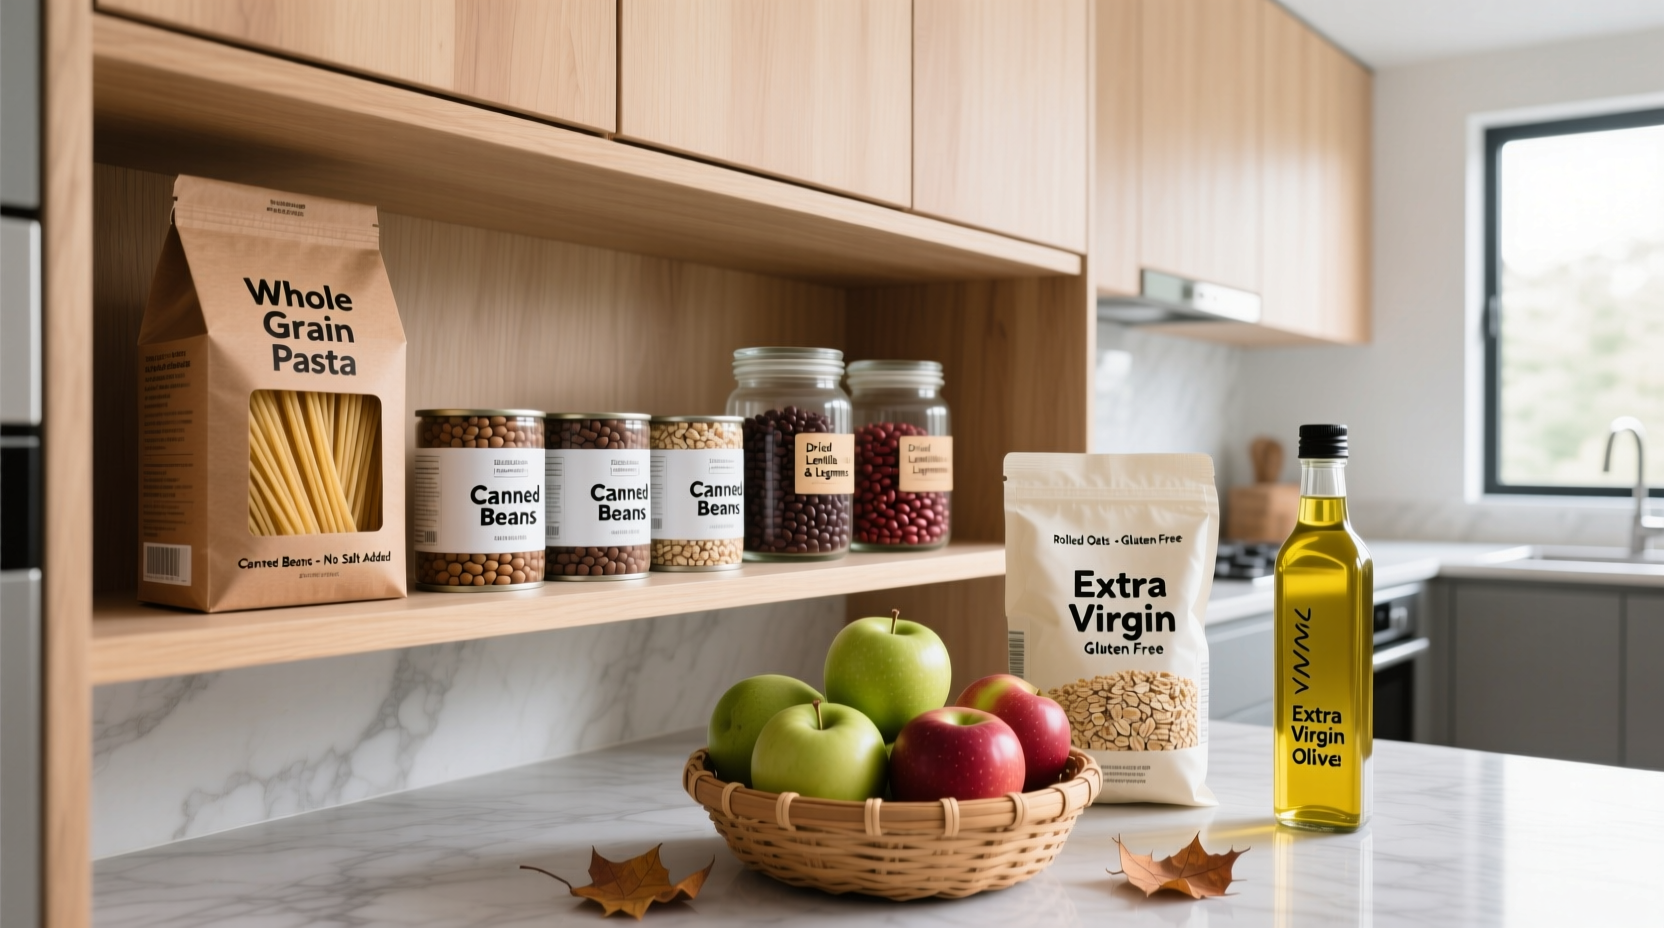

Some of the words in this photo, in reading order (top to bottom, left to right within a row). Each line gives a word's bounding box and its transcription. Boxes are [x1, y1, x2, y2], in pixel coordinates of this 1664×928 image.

[242, 276, 354, 312] Whole
[262, 310, 355, 343] Grain
[271, 343, 357, 376] Pasta
[804, 467, 812, 477] &
[470, 484, 540, 505] Canned
[590, 483, 648, 502] Canned
[690, 480, 743, 498] Canned
[480, 507, 537, 527] Beans
[598, 504, 647, 522] Beans
[697, 500, 740, 517] Beans
[1053, 534, 1084, 546] Rolled
[1121, 534, 1157, 546] Gluten
[1158, 533, 1183, 545] Free
[324, 553, 338, 566] No
[341, 552, 360, 564] Salt
[1074, 569, 1167, 598] Extra
[1068, 603, 1176, 641] Virgin
[1084, 641, 1129, 655] Gluten
[1133, 642, 1164, 655] Free
[1292, 705, 1342, 724] Extra
[1291, 725, 1345, 748] Virgin
